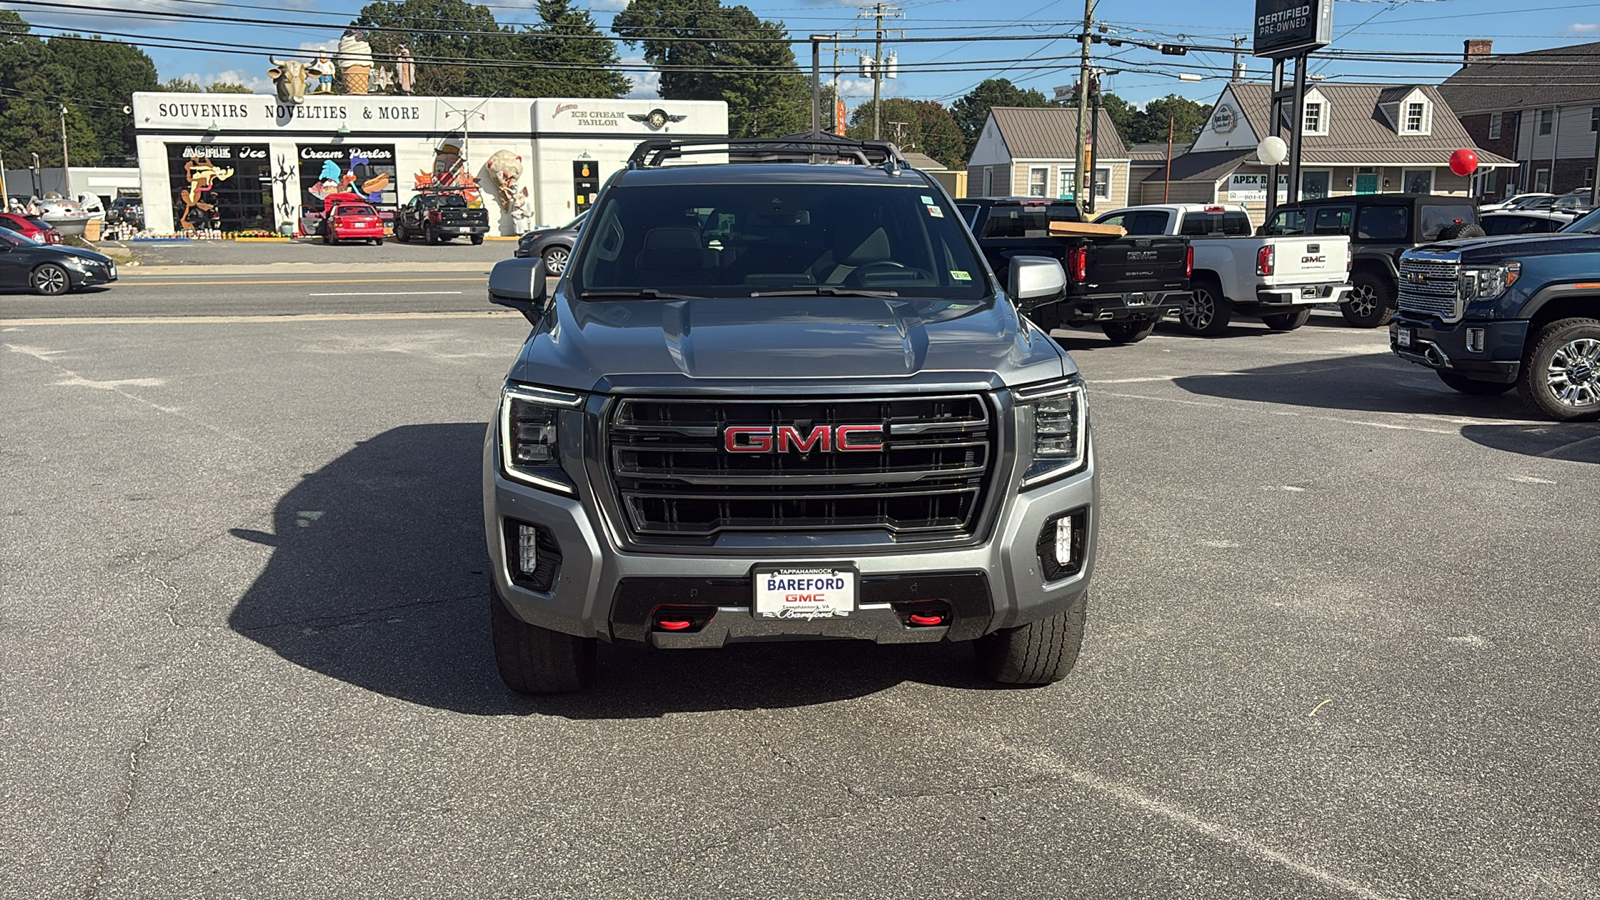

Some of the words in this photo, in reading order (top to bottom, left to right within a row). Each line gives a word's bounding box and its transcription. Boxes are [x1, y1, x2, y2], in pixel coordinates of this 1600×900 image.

[1258, 5, 1310, 26] CERTIFIED
[1260, 17, 1307, 36] PRE-OWNED
[159, 103, 248, 118] SOUVENIRS
[265, 105, 347, 119] NOVELTIES
[362, 106, 373, 120] &
[378, 106, 420, 120] MORE
[182, 145, 231, 158] ACME
[239, 146, 267, 159] Ice
[301, 147, 344, 159] Cream
[348, 147, 392, 159] Parlor
[1233, 175, 1258, 184] APEX
[1127, 251, 1157, 259] GMC
[724, 425, 884, 452] GMC
[767, 578, 845, 591] BAREFORD
[785, 593, 825, 602] GMC
